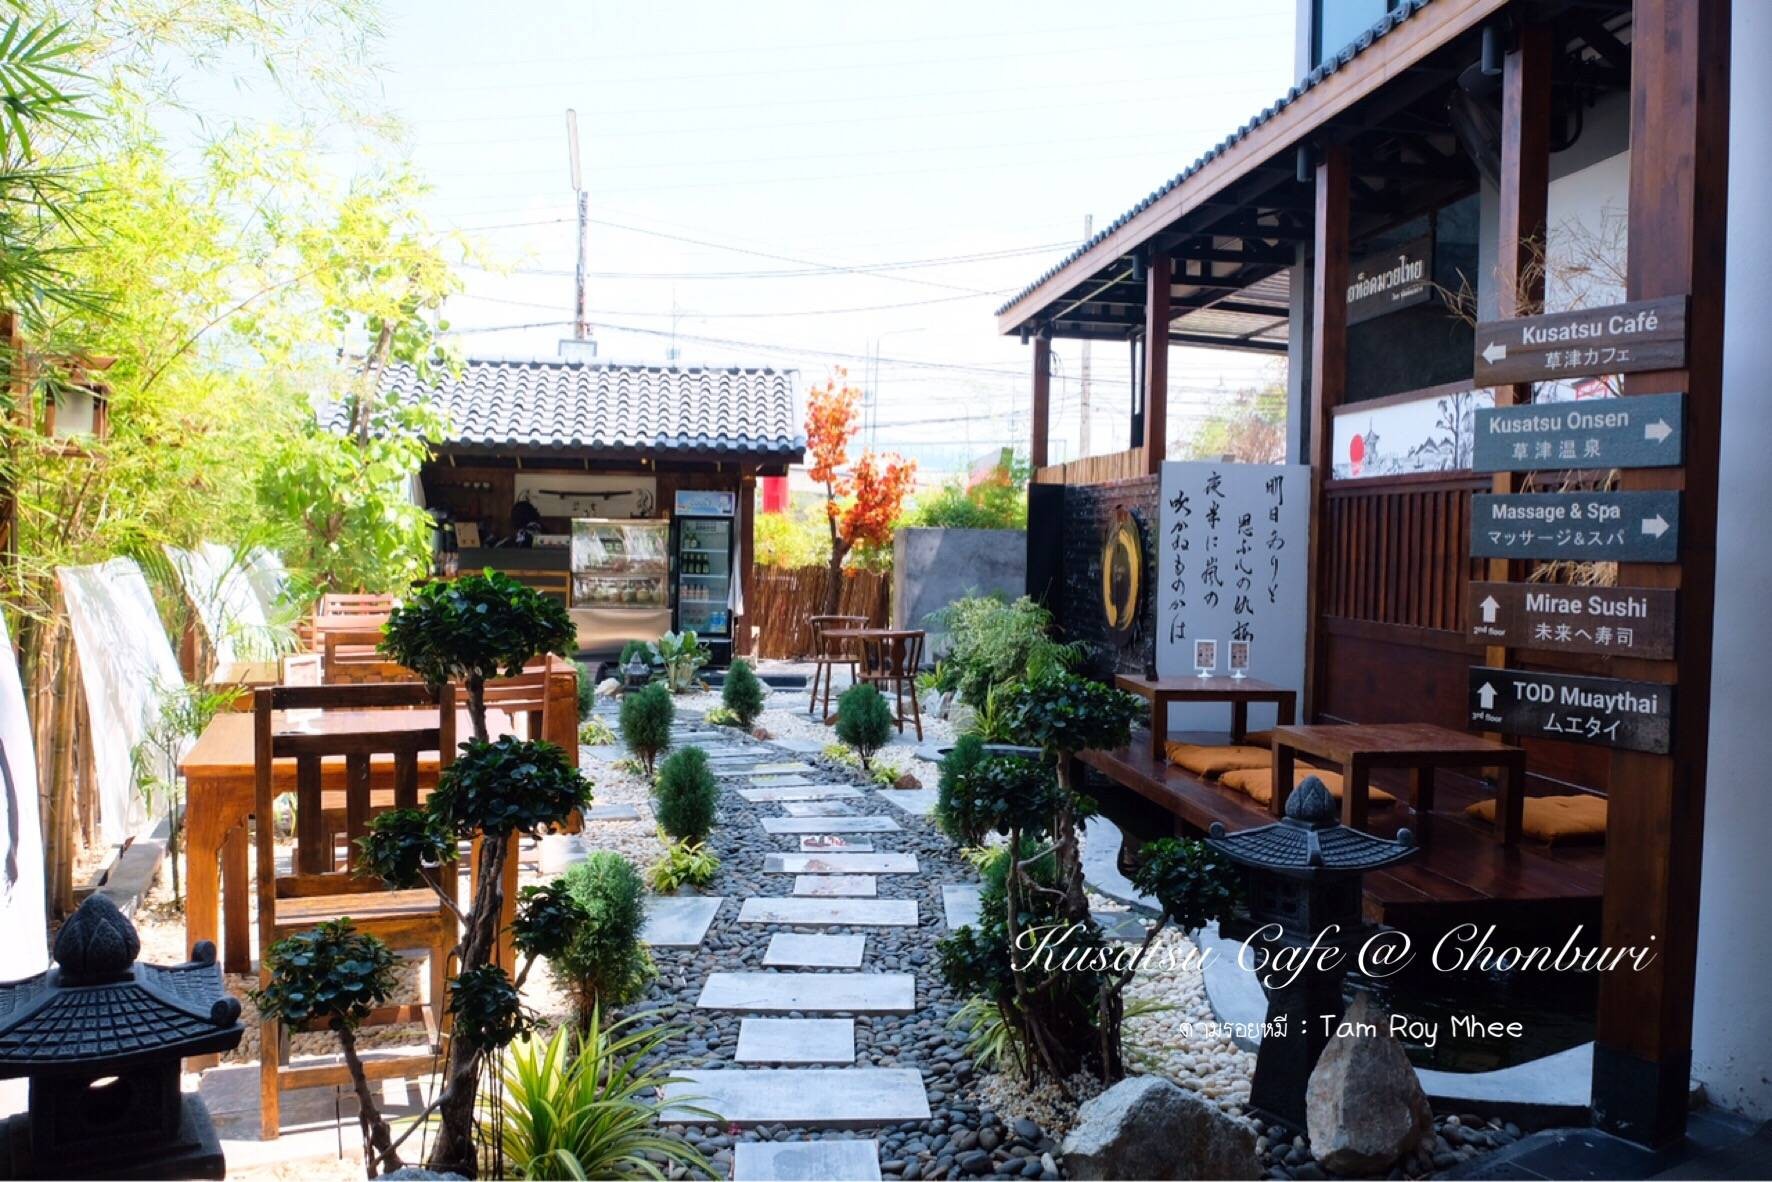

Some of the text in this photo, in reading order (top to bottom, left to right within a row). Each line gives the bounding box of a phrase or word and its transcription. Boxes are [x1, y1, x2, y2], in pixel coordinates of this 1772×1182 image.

[1523, 310, 1659, 345] Kusatsu Café
[1544, 346, 1631, 370] 草津カフェ
[1489, 411, 1629, 434] Kusatsu Onsen
[1512, 438, 1601, 461] 草津温泉
[1492, 503, 1621, 523] Massage & Spa
[1488, 528, 1625, 546] マッサージ&スパ
[1526, 593, 1648, 618] Mirae Sushi
[1534, 621, 1634, 647] 未来へ寿司
[1513, 681, 1658, 714] TOD Muaythai
[1543, 712, 1621, 741] ムエタイ
